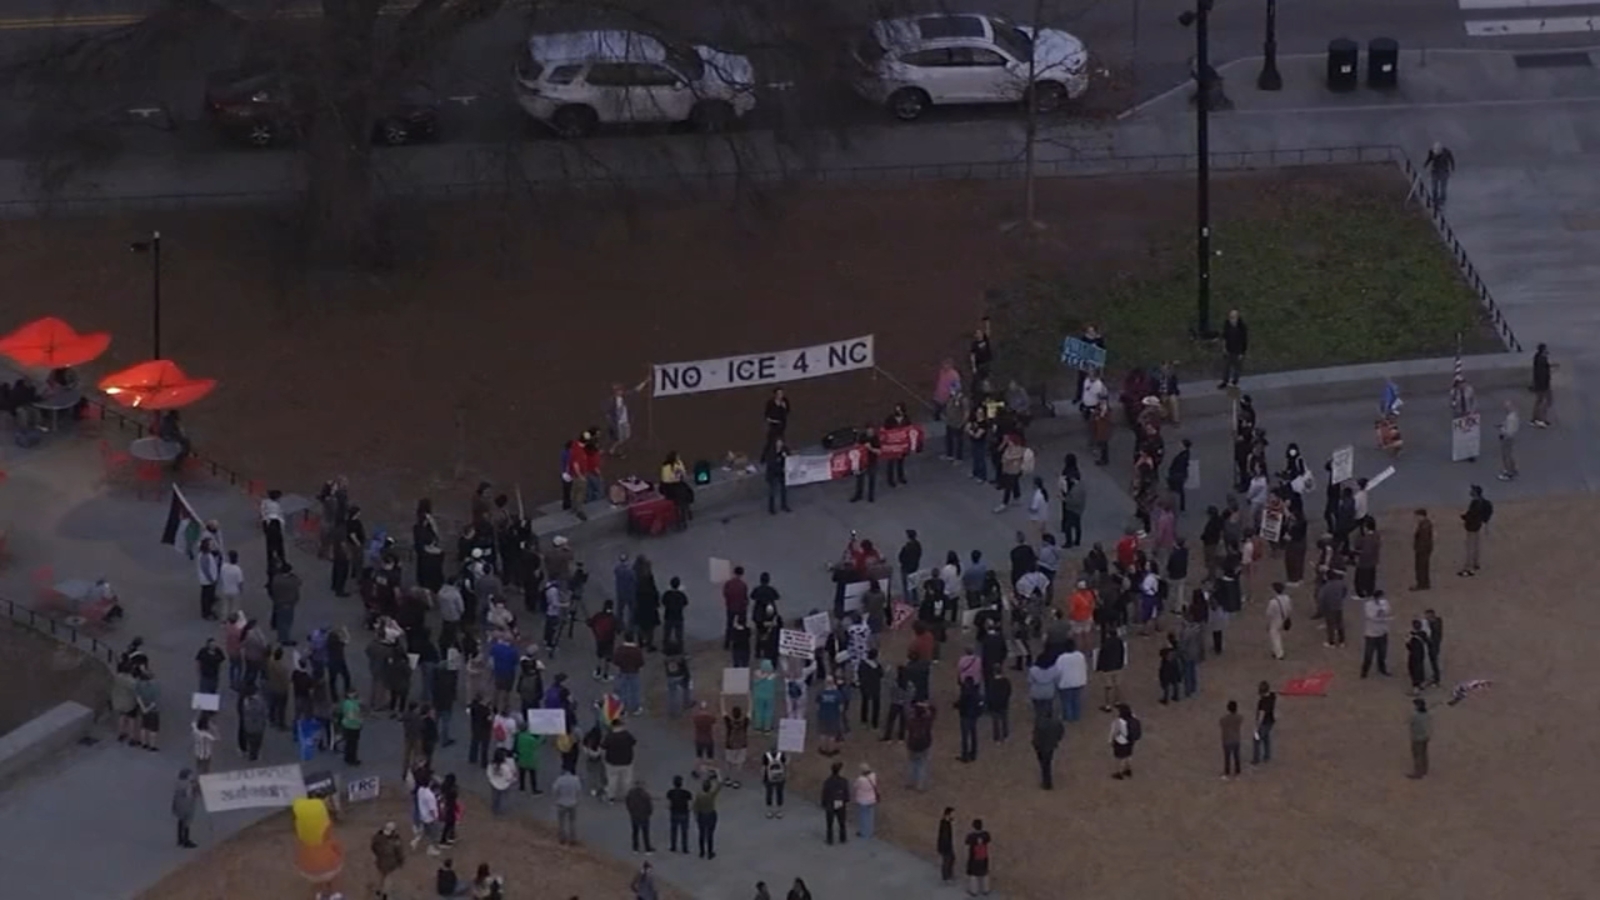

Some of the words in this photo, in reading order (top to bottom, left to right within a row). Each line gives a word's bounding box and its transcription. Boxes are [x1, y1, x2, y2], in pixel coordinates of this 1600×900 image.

[660, 366, 702, 391] NO
[728, 356, 776, 383] ICE
[792, 351, 809, 374] 4
[828, 341, 868, 368] NC
